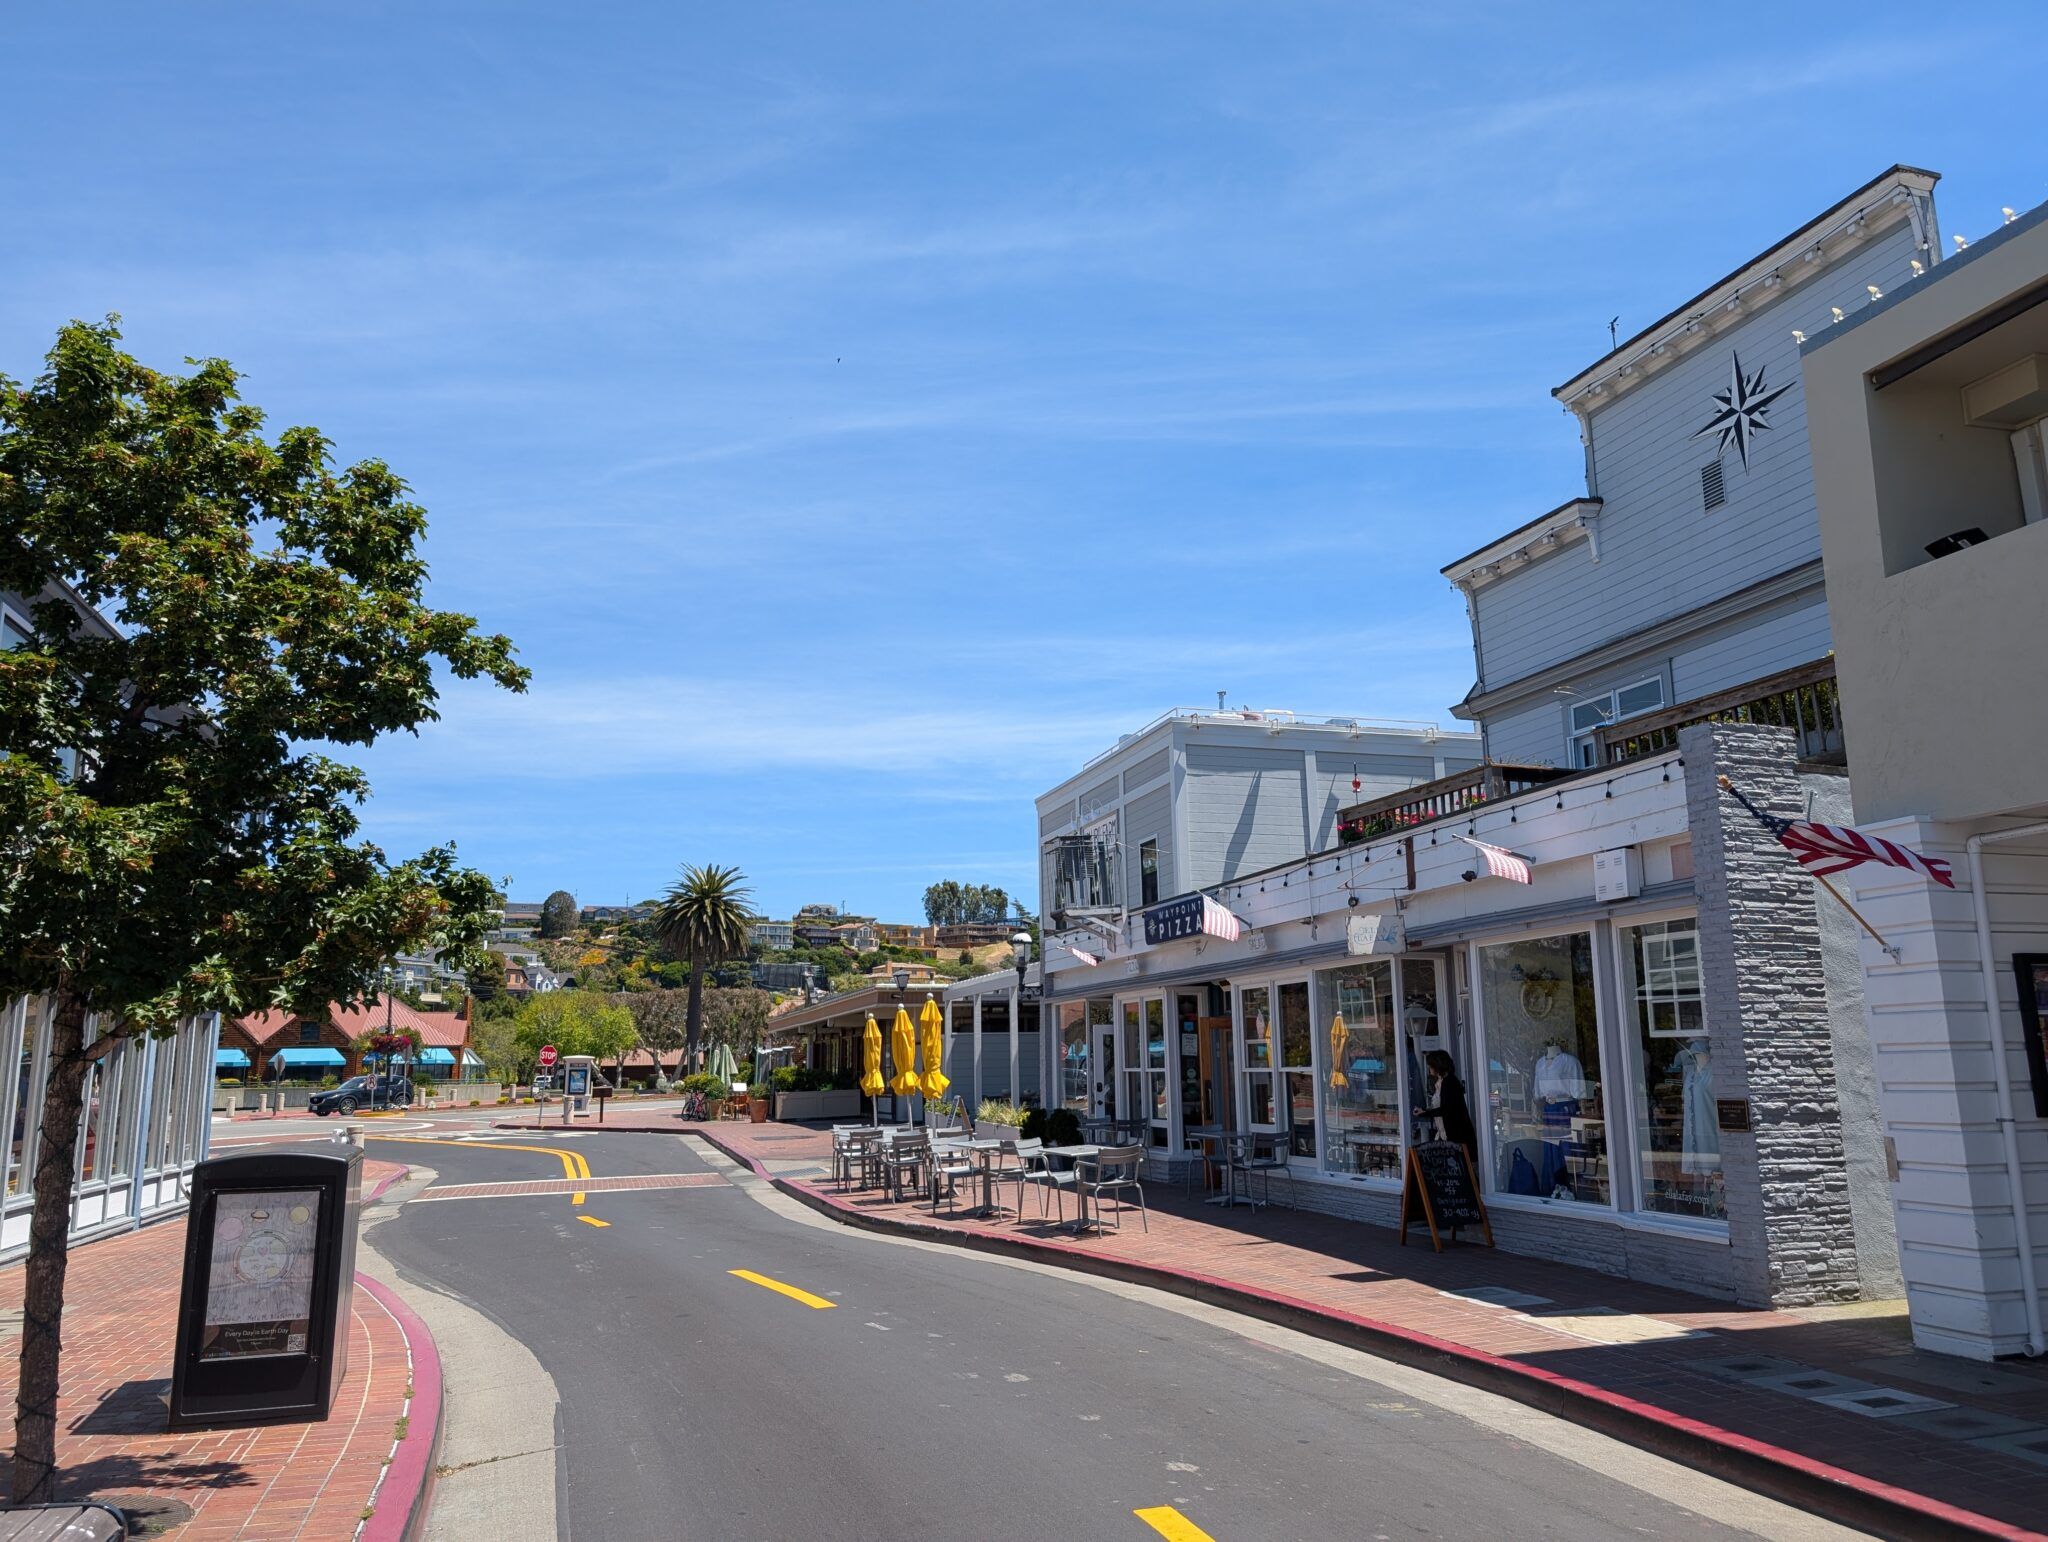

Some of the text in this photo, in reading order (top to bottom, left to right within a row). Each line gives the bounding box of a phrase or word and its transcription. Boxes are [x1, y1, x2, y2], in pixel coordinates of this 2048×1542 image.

[1158, 900, 1202, 920] WAYPOINT
[1159, 914, 1203, 939] PIZZA
[541, 1051, 556, 1060] STOP
[224, 1330, 241, 1338] Every
[277, 1327, 289, 1335] Day
